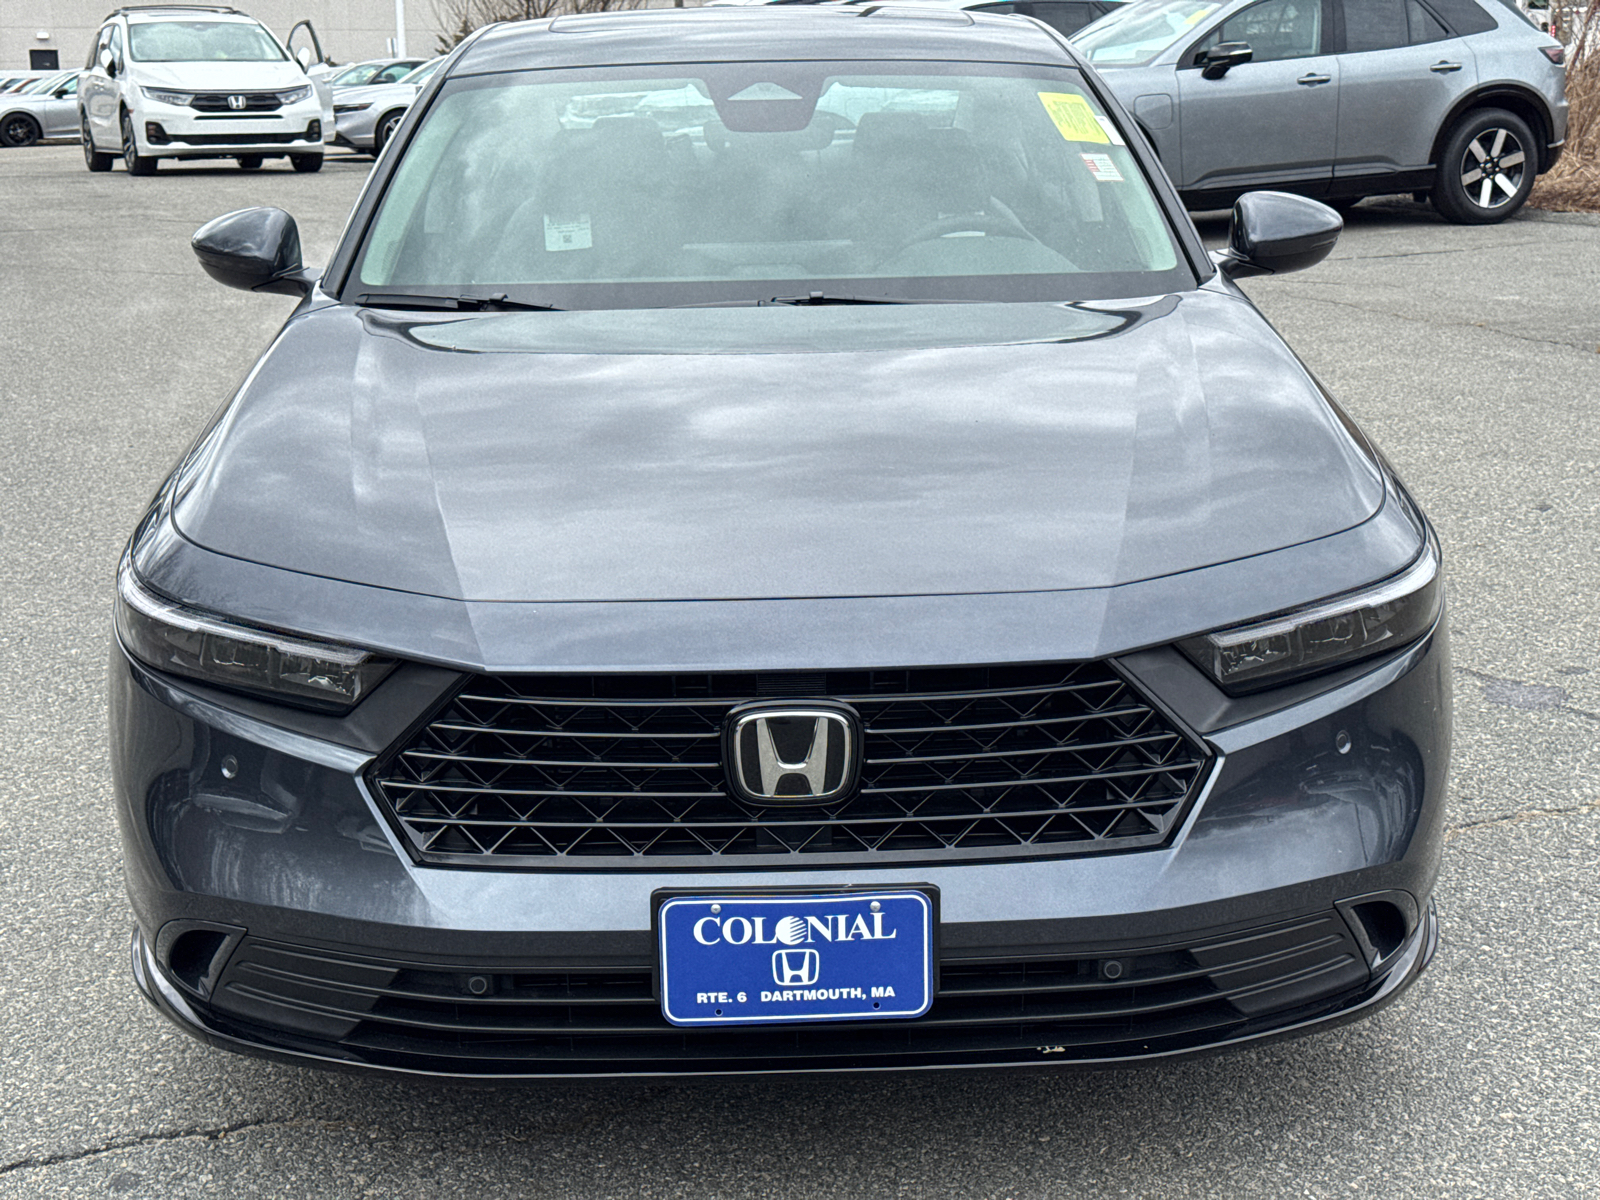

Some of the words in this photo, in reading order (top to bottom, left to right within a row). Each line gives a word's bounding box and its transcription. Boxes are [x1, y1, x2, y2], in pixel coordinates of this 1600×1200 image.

[693, 911, 897, 946] COLONIAL
[696, 992, 733, 1004] RTE.
[736, 991, 748, 1003] 6
[760, 987, 867, 1003] DARTMOUTH,
[870, 985, 896, 998] MA
